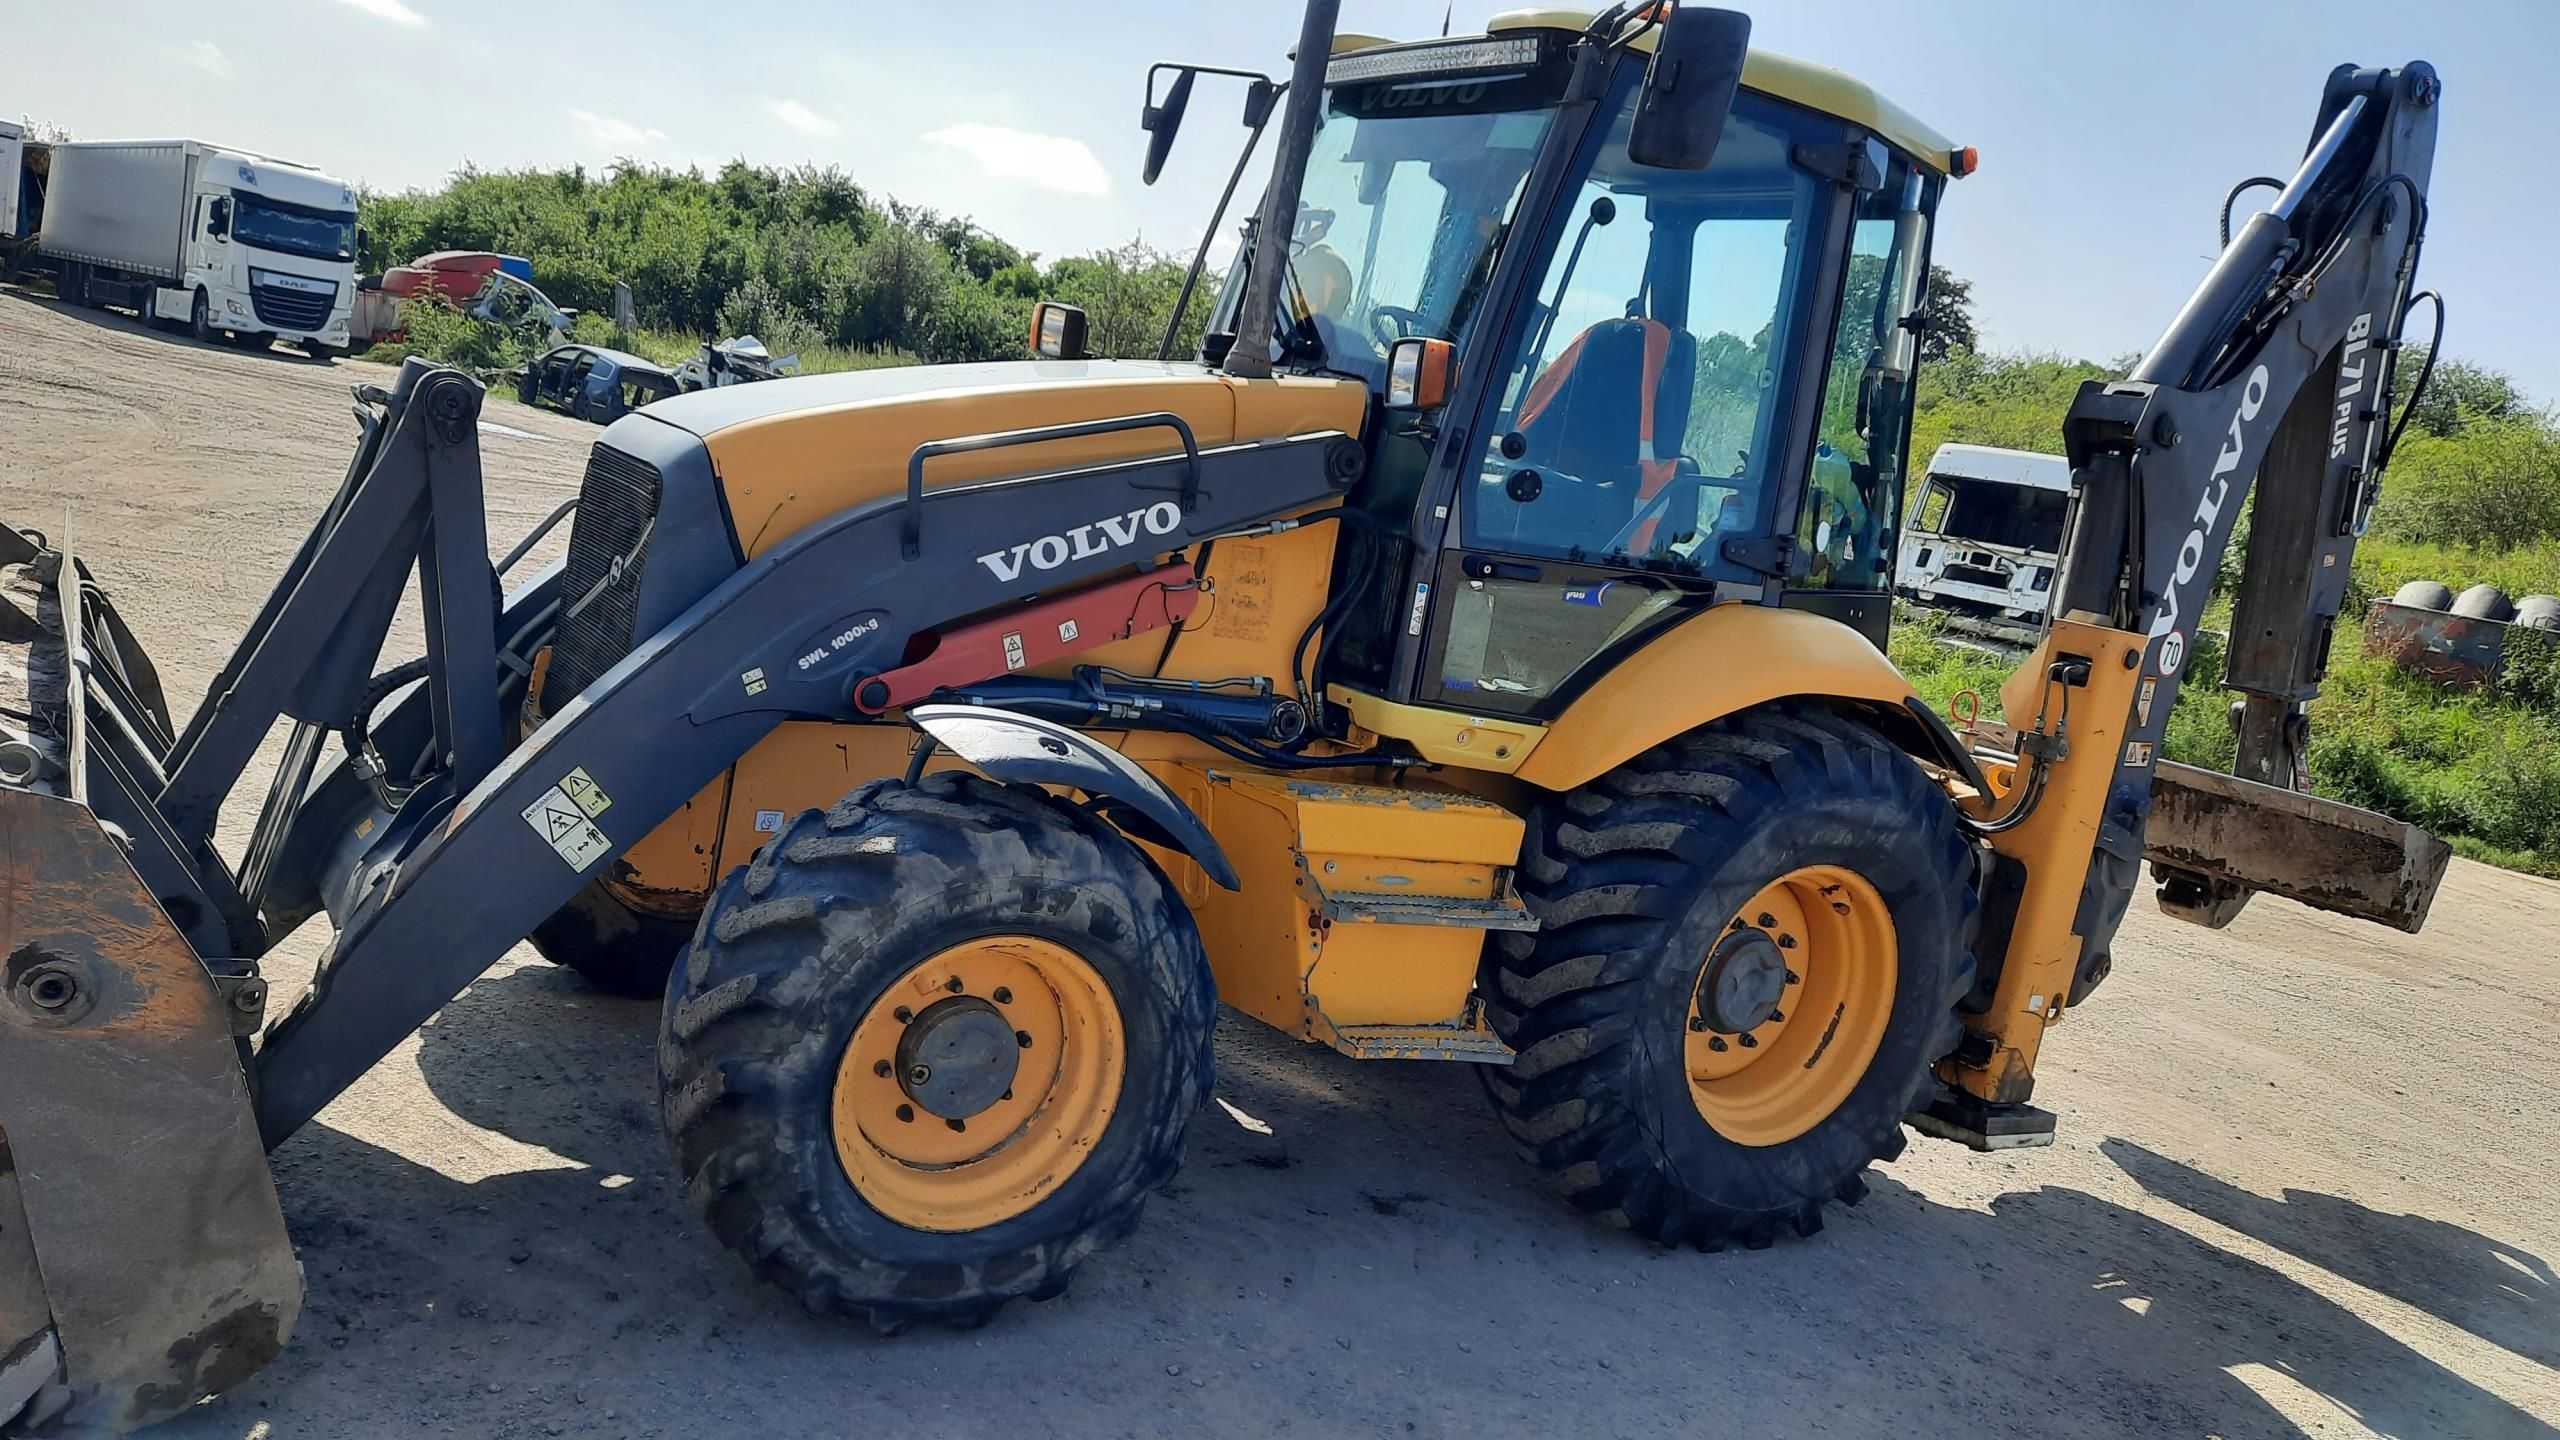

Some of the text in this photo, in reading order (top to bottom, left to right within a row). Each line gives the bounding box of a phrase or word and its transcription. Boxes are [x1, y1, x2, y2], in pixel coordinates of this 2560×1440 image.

[1362, 81, 1488, 111] VOLVO
[279, 280, 309, 289] DAF
[2331, 312, 2372, 460] BL71 PLUS
[2149, 364, 2269, 639] VOLVO
[977, 502, 1181, 583] VOLVO
[798, 618, 879, 670] SWL 1000kg
[2165, 641, 2181, 667] 70
[529, 788, 561, 815] WARNING
